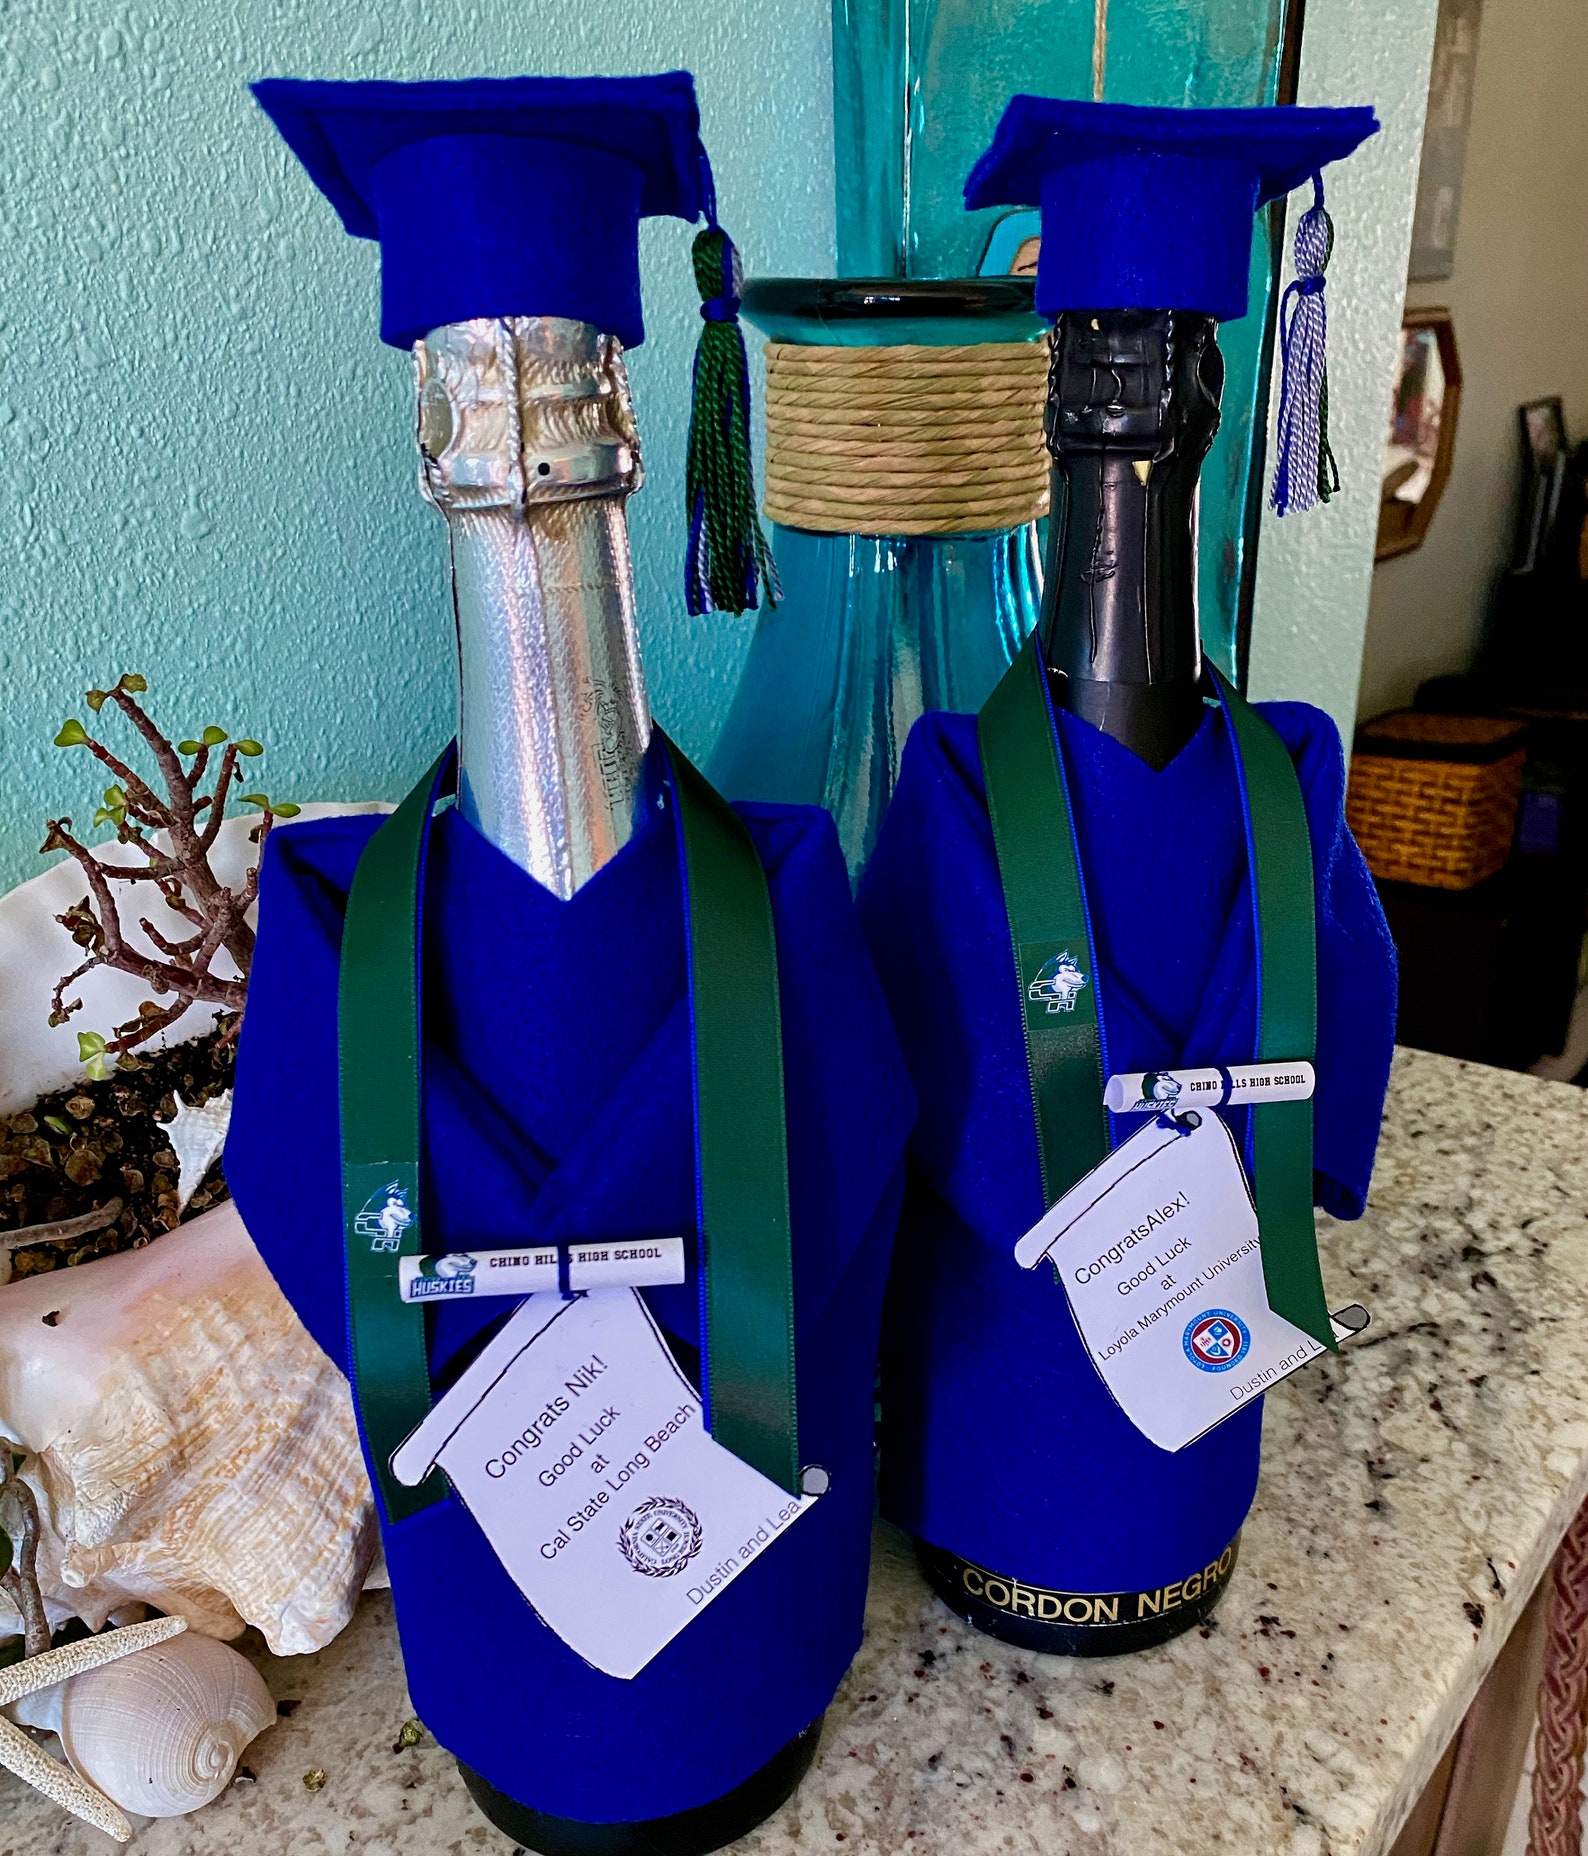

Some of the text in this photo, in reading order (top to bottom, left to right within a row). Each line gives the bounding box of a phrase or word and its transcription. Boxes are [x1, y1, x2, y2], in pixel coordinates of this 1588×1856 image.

[1190, 1080, 1217, 1091] CHINO
[1250, 1078, 1271, 1088] HIGH
[1274, 1075, 1306, 1086] SCHOOL
[490, 1248, 662, 1268] CHINO HILS HIGH SCHOOL
[1075, 1191, 1190, 1284] CongratsAlex!
[1117, 1237, 1192, 1295] Good Luck
[411, 1278, 474, 1296] HUSKIES
[1160, 1274, 1177, 1290] at
[1098, 1328, 1139, 1361] Loyola
[1137, 1277, 1204, 1330] Marymount
[1230, 1345, 1308, 1400] Dustin and
[485, 1354, 608, 1478] Congrats Nik!
[539, 1406, 621, 1487] Good Luck
[540, 1403, 696, 1559] Cal State Long Beach
[590, 1453, 610, 1474] at
[686, 1501, 802, 1605] Dustin and Lea
[962, 1546, 1232, 1623] CORDON NEGRO
